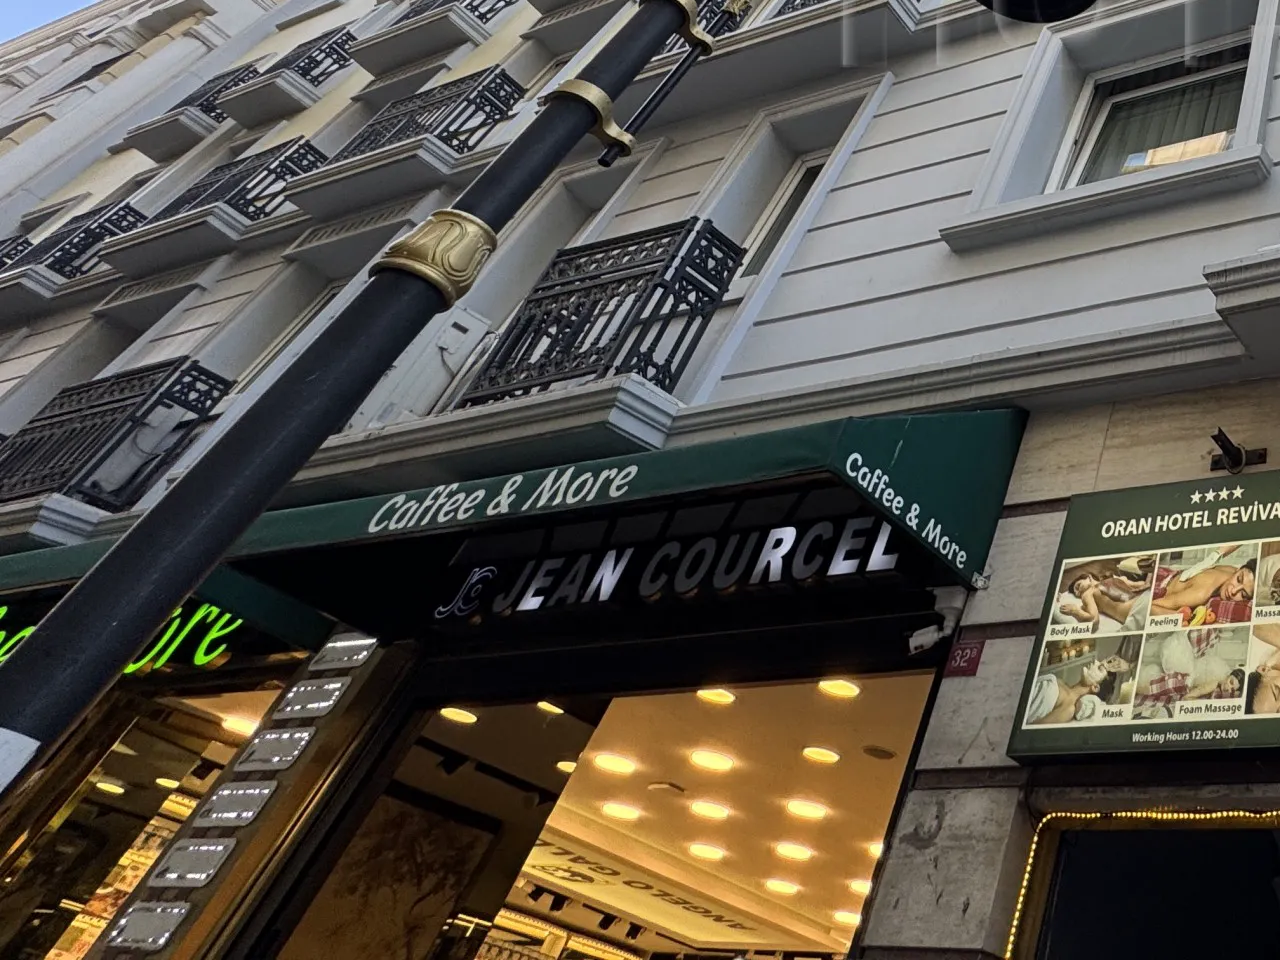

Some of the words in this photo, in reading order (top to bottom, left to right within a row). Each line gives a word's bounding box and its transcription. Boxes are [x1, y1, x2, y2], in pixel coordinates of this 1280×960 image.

[367, 483, 486, 533] Caffee
[486, 474, 524, 516] &
[521, 464, 639, 511] More
[845, 452, 904, 515] Caffee
[905, 503, 920, 531] &
[921, 518, 967, 569] More
[1100, 517, 1151, 538] ORAN
[1154, 508, 1213, 533] HOTEL
[492, 547, 635, 613] JEAN
[638, 515, 900, 597] COURCEL
[1150, 616, 1179, 628] Peeling
[1050, 627, 1070, 637] Body
[1070, 624, 1091, 635] Mask
[1101, 708, 1124, 719] Mask
[1179, 704, 1203, 715] Foam
[1204, 702, 1243, 715] Massage
[1132, 732, 1165, 744] Working
[1166, 730, 1190, 741] Hours
[1191, 728, 1239, 740] 12.00-24.00
